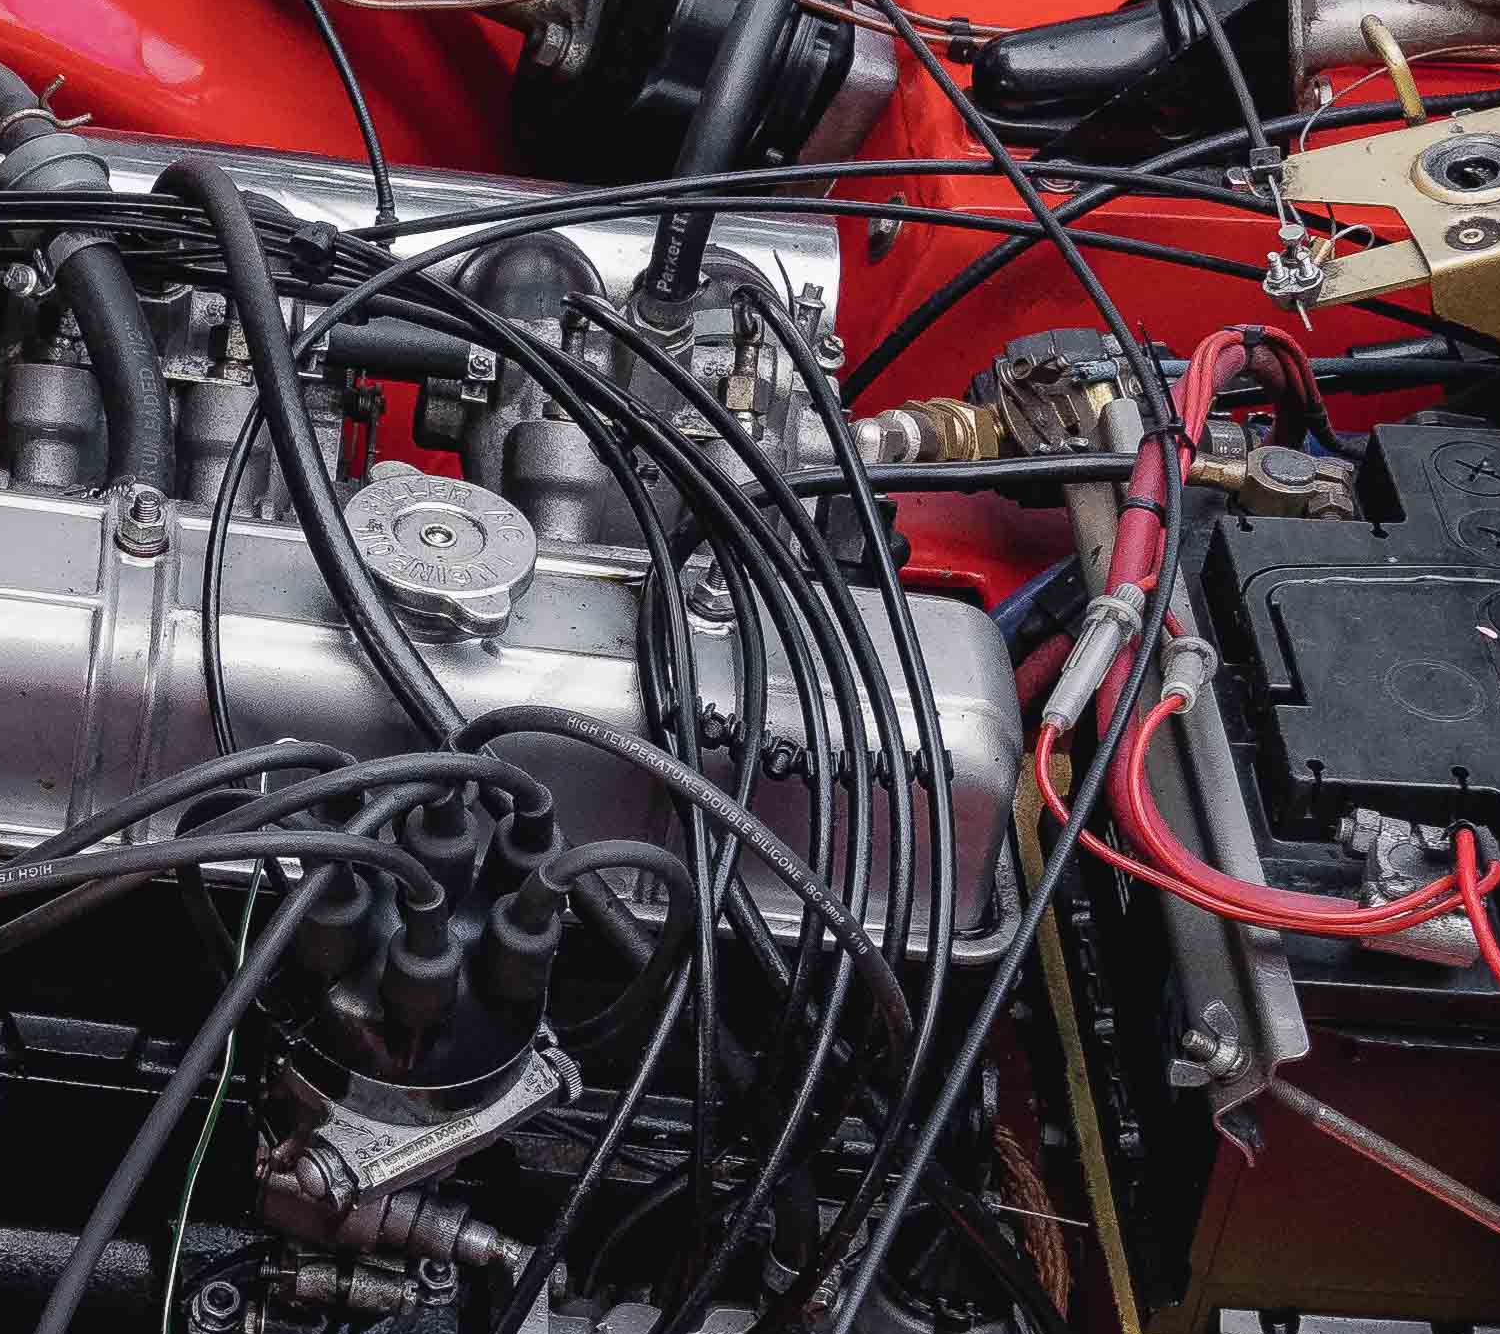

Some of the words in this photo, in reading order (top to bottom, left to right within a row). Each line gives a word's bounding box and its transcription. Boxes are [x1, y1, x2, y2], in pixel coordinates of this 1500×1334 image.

[656, 237, 682, 293] Parker
[567, 716, 600, 734] HIGH
[602, 729, 700, 795] TEMPERATURE
[700, 789, 753, 835] DOUBLE
[751, 831, 804, 883] SILICONE
[18, 863, 54, 878] HIGH
